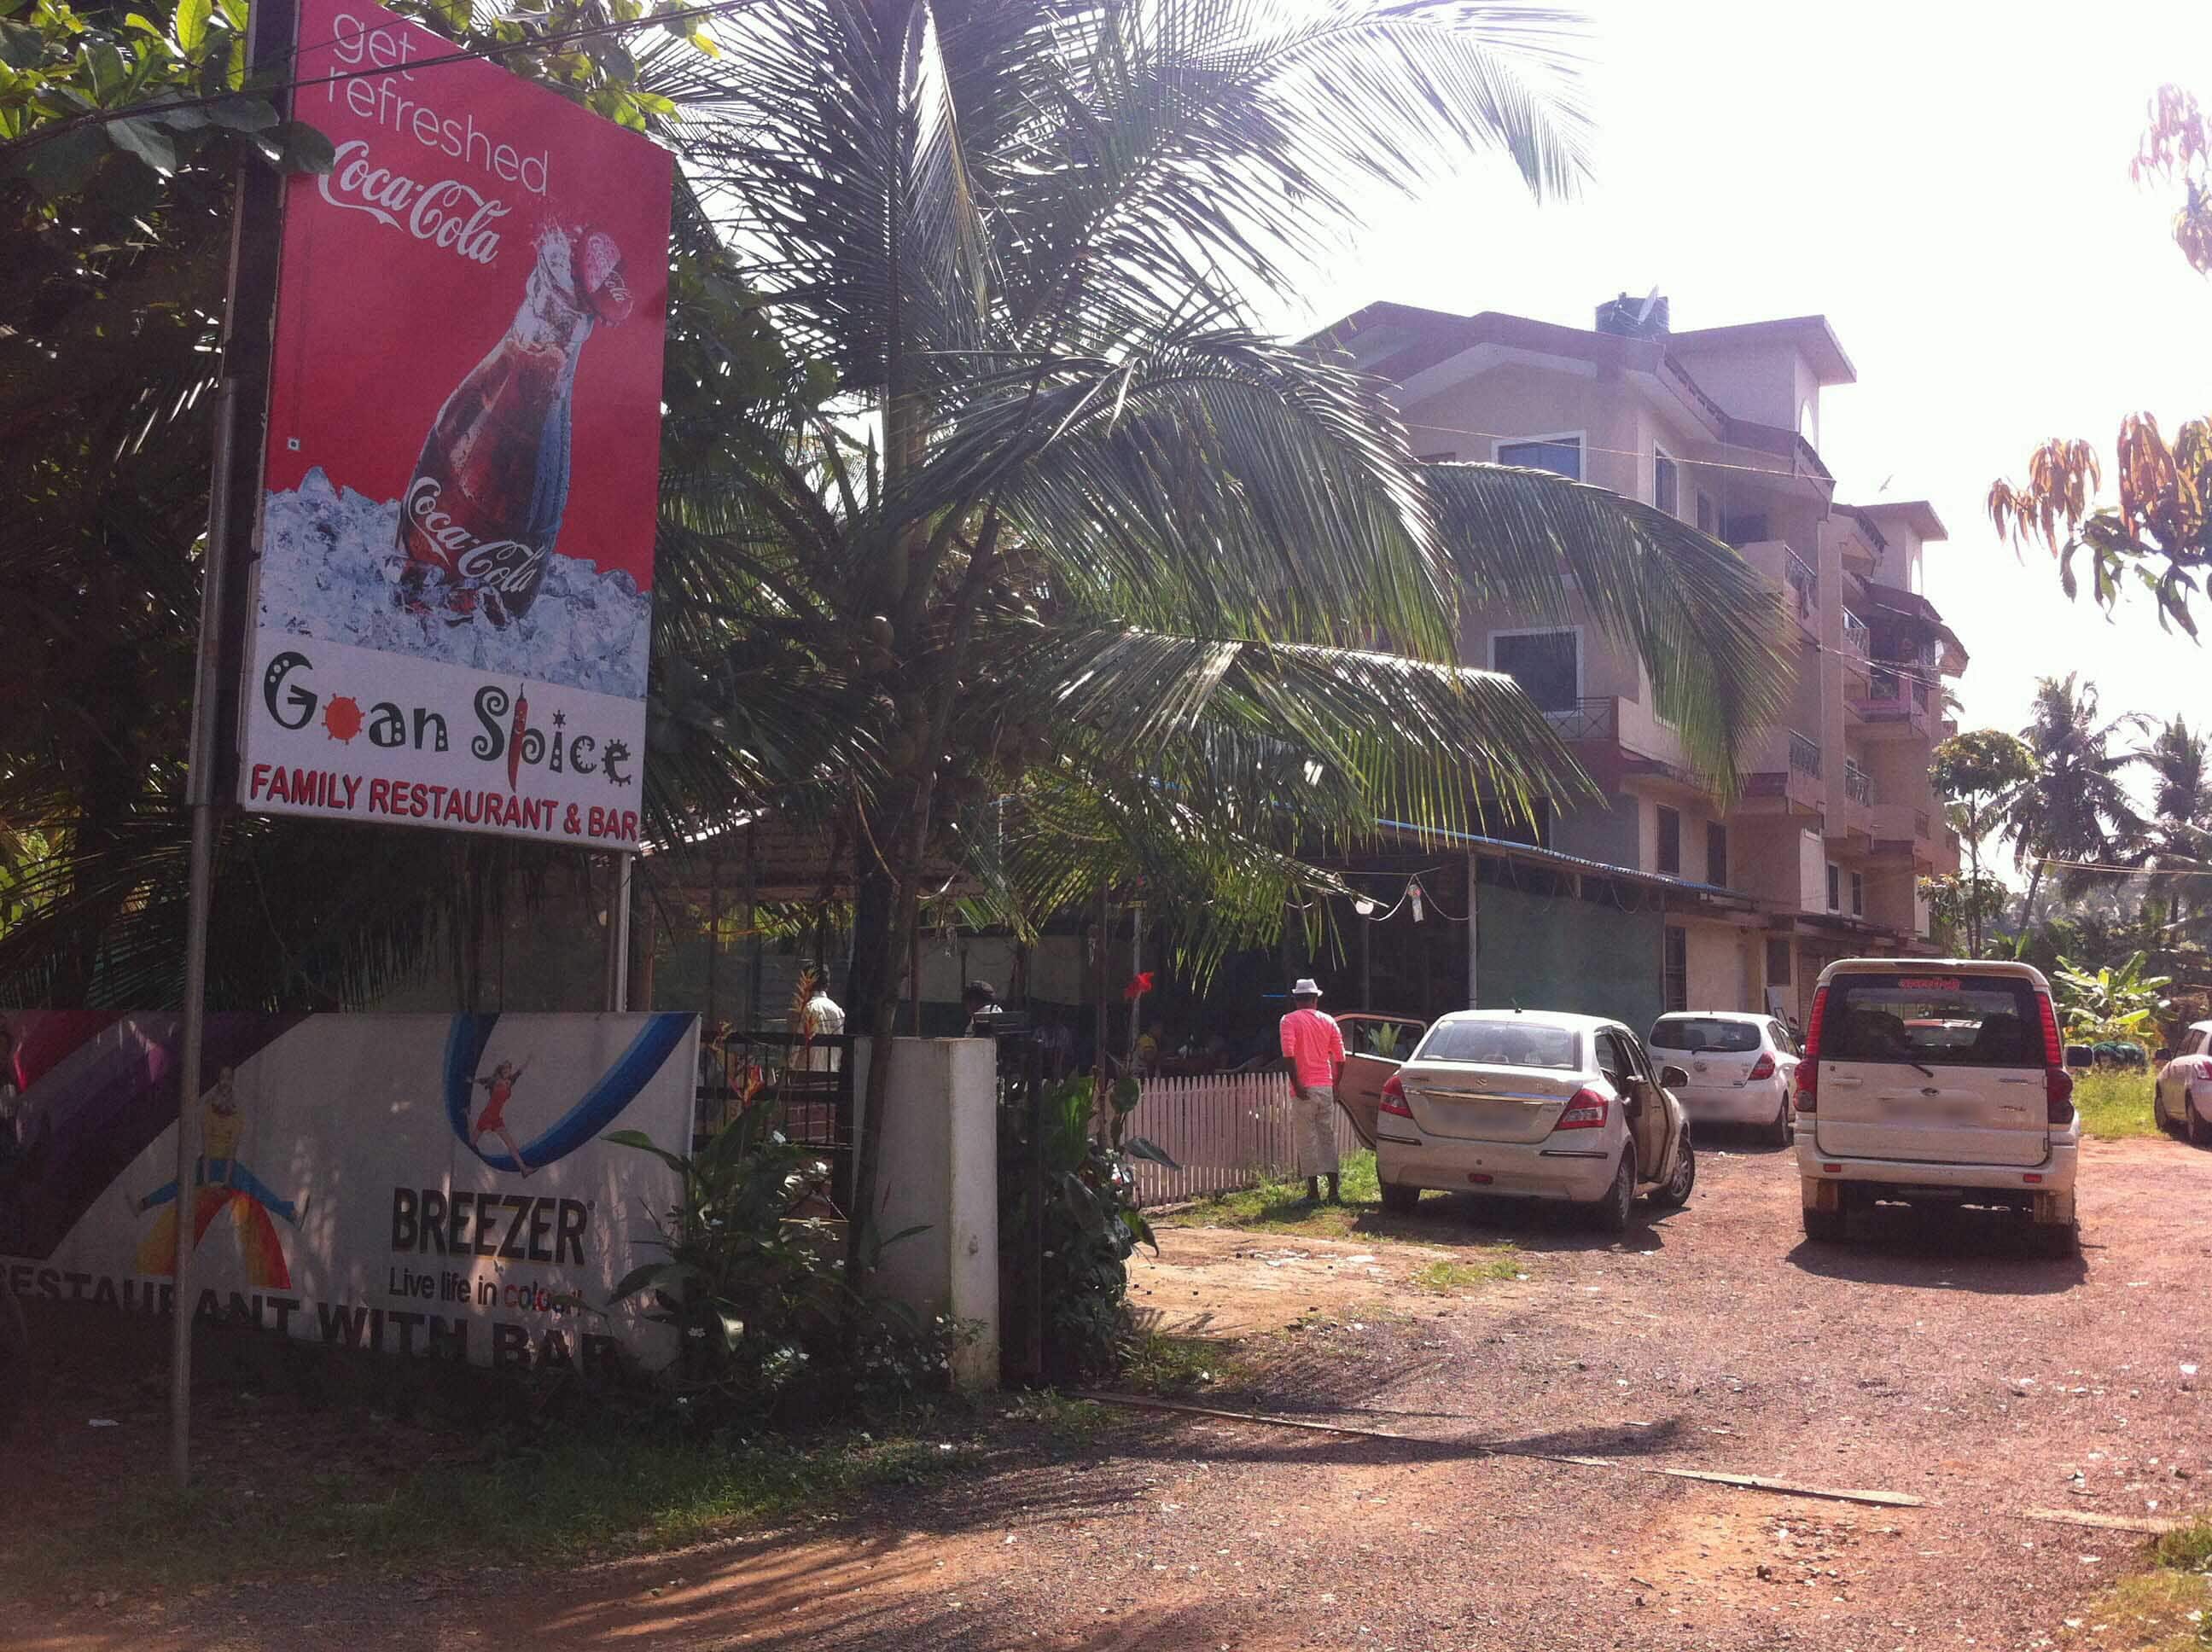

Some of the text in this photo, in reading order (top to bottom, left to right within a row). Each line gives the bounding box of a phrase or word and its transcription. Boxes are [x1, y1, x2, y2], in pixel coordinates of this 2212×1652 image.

[333, 13, 416, 81] get
[328, 66, 549, 196] refreshed
[317, 140, 513, 265] Coca-Cola
[263, 650, 632, 794] Goan Spice
[250, 764, 638, 842] FAMILY RESTAURANT & BAR
[391, 1187, 588, 1265] BREEZER
[388, 1266, 435, 1299] Live
[440, 1270, 471, 1303] life
[477, 1275, 497, 1306] in
